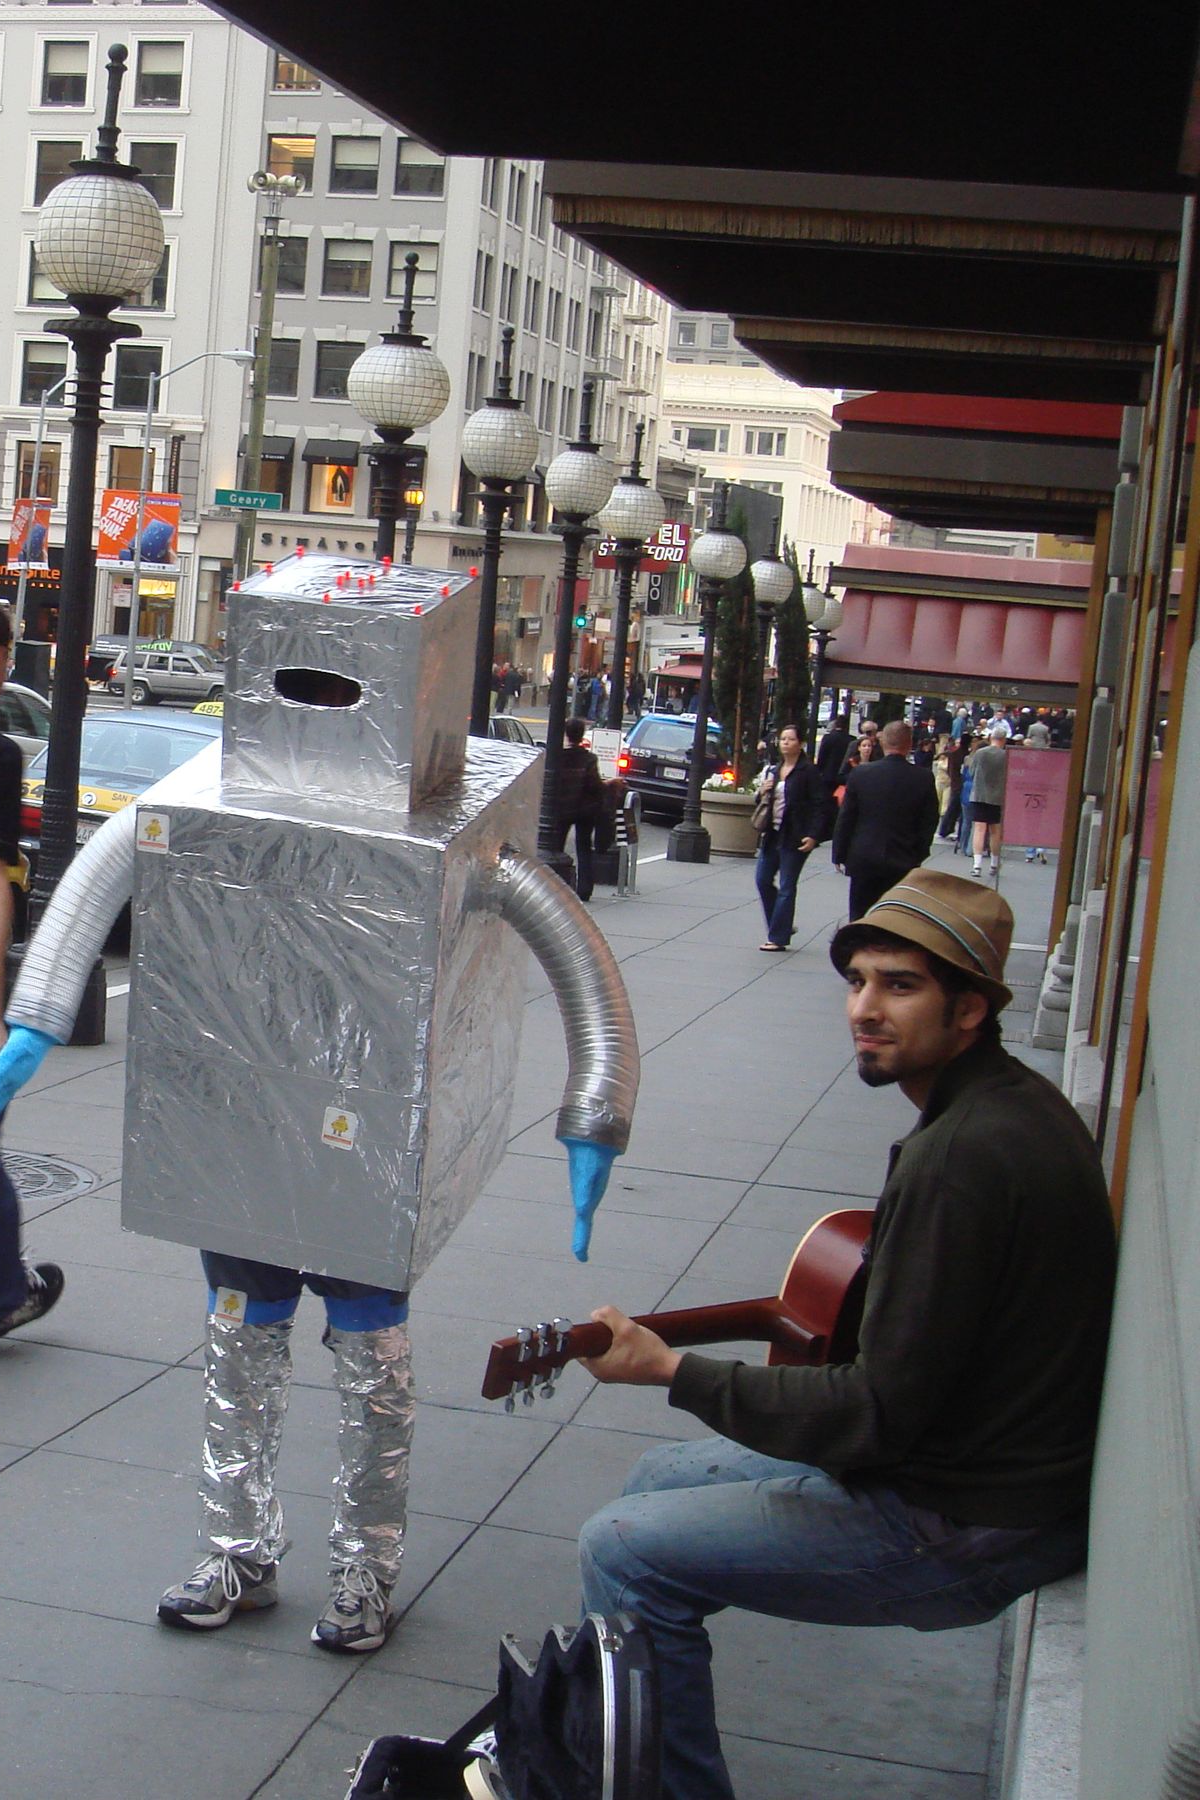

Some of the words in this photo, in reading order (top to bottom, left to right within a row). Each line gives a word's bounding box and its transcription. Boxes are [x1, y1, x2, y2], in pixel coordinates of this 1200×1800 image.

[110, 496, 140, 515] IDEAS
[229, 493, 267, 508] Geary
[105, 507, 133, 527] TAKE
[99, 516, 125, 541] SHAPE
